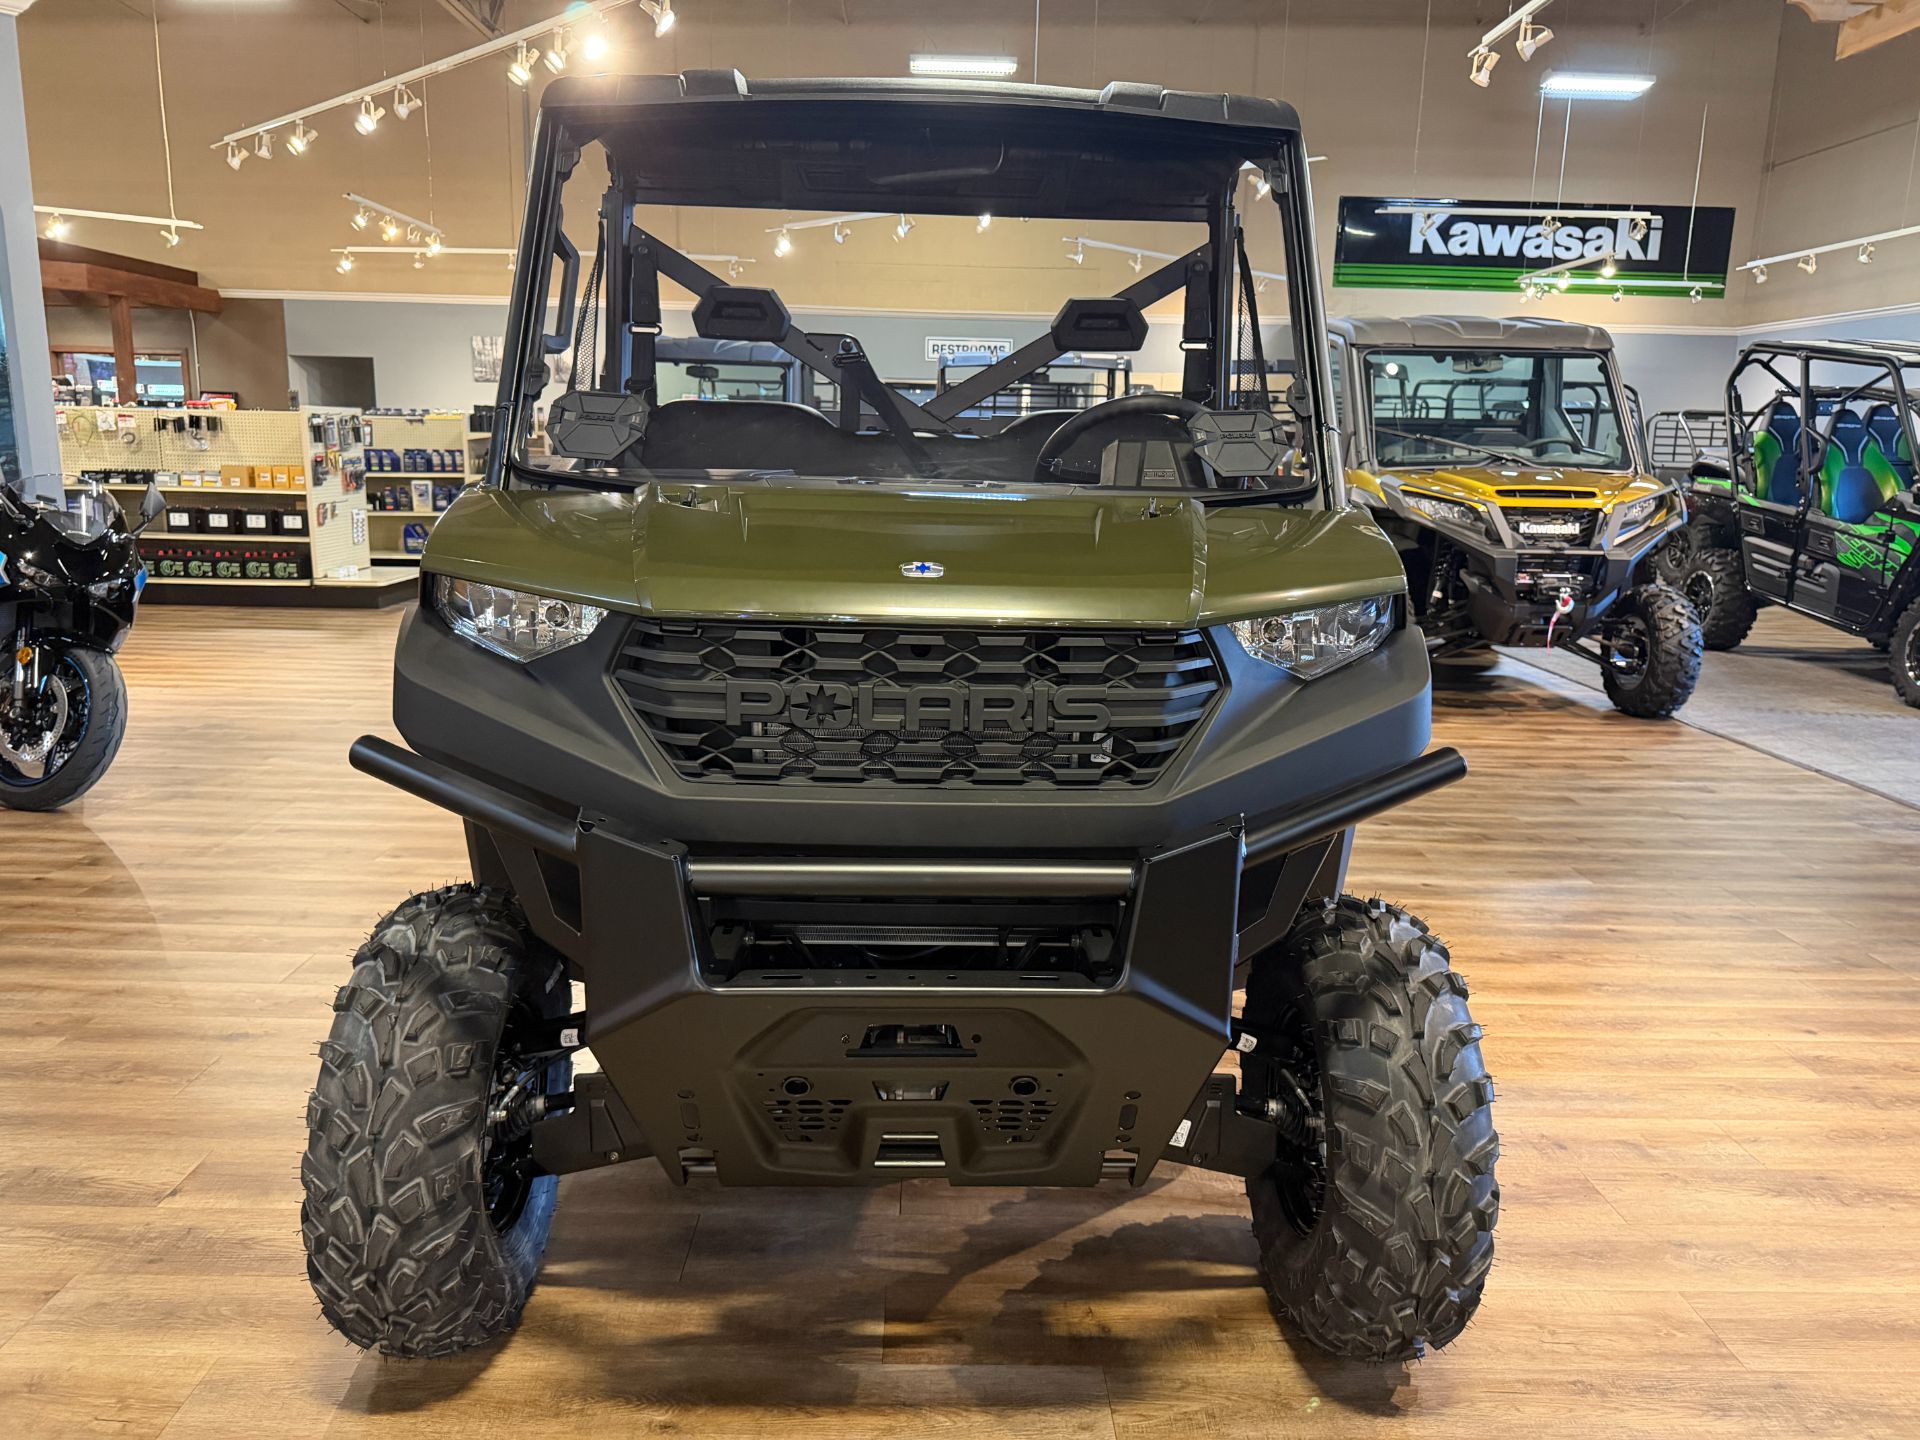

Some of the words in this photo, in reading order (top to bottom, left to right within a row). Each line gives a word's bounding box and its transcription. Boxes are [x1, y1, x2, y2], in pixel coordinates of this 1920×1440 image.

[1409, 211, 1663, 261] Kawasaki
[932, 344, 1006, 355] RESTROOMS
[1519, 522, 1580, 535] Kawasaki
[726, 679, 1112, 732] POLARIS
